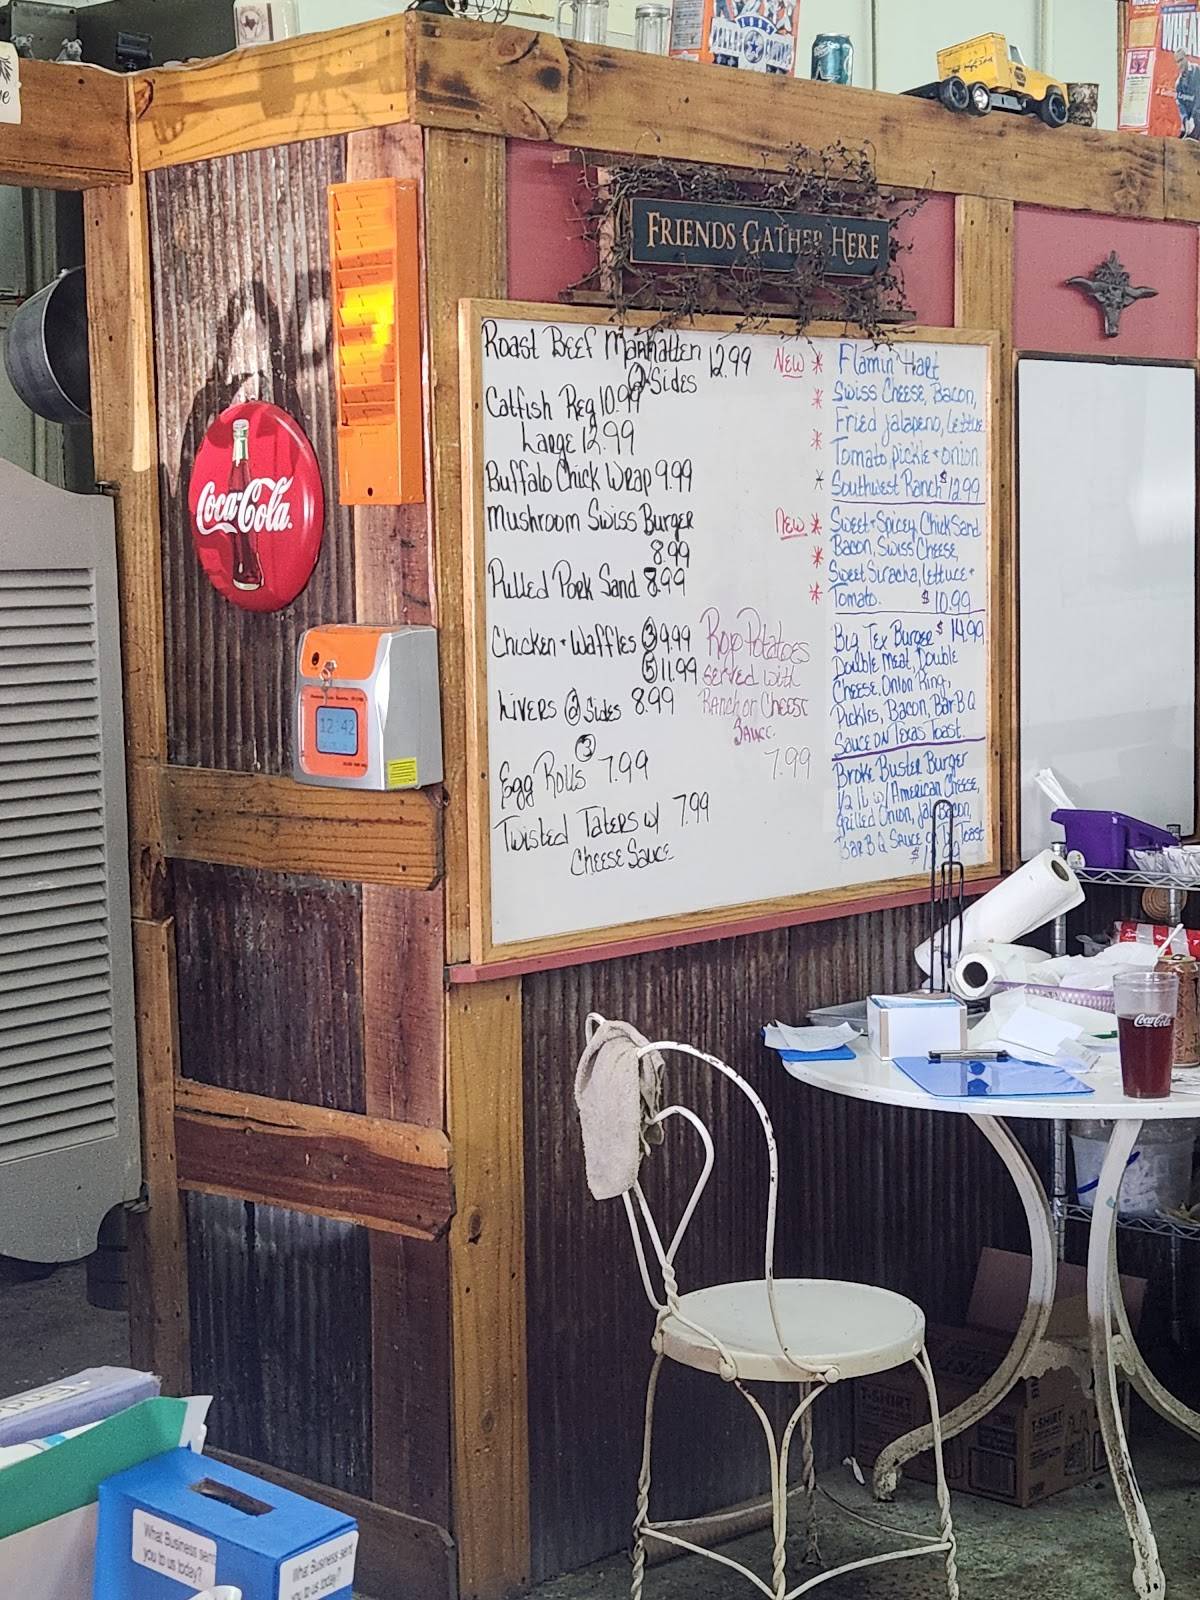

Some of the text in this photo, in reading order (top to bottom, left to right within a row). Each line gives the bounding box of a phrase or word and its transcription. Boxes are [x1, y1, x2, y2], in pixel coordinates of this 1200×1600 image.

[647, 212, 879, 264] FRIENDS GATHER HERE
[482, 320, 540, 359] Roast
[543, 326, 596, 359] Beef
[710, 346, 751, 378] 12.99
[650, 368, 697, 394] Sides
[832, 380, 877, 401] Swiss
[486, 385, 552, 420] Catfish
[559, 384, 597, 428] Reg
[835, 406, 877, 432] Fried
[522, 420, 634, 460] Large 12.99
[830, 436, 887, 468] Tomato
[486, 458, 692, 496] Buffalo Chick Wrap 9.99
[832, 470, 898, 496] Southwest
[901, 469, 941, 499] Ranch
[196, 476, 293, 534] Coca-Cola
[487, 498, 694, 541] Mushroom Swiss Burger
[920, 511, 951, 536] Chick
[951, 514, 982, 537] Sand
[651, 539, 689, 568] 8.99
[878, 536, 914, 557] Swiss
[488, 558, 685, 600] Pulled Pork Sand 8.99
[829, 560, 864, 584] Sweet
[492, 625, 556, 657] Chicken
[571, 623, 636, 658] Waffles
[660, 624, 690, 654] 9.99
[834, 623, 858, 652] Big
[863, 623, 887, 650] Tex
[662, 657, 697, 684] 11.99
[832, 653, 879, 680] Double
[916, 646, 958, 669] Double
[882, 675, 912, 696] Onion
[583, 696, 621, 722] Sides
[632, 686, 674, 715] 8.99
[320, 717, 356, 736] 12:42
[835, 732, 870, 757] Sauce
[889, 721, 925, 743] Texas
[764, 747, 810, 779] 7.99
[924, 751, 968, 778] Burger
[500, 750, 648, 810] Egg Rolls 7.99
[891, 781, 942, 803] American
[494, 814, 568, 852] Twisted
[577, 806, 638, 837] Taters
[672, 792, 709, 826] 7.99
[890, 829, 922, 847] Sauce
[571, 846, 624, 875] Cheese
